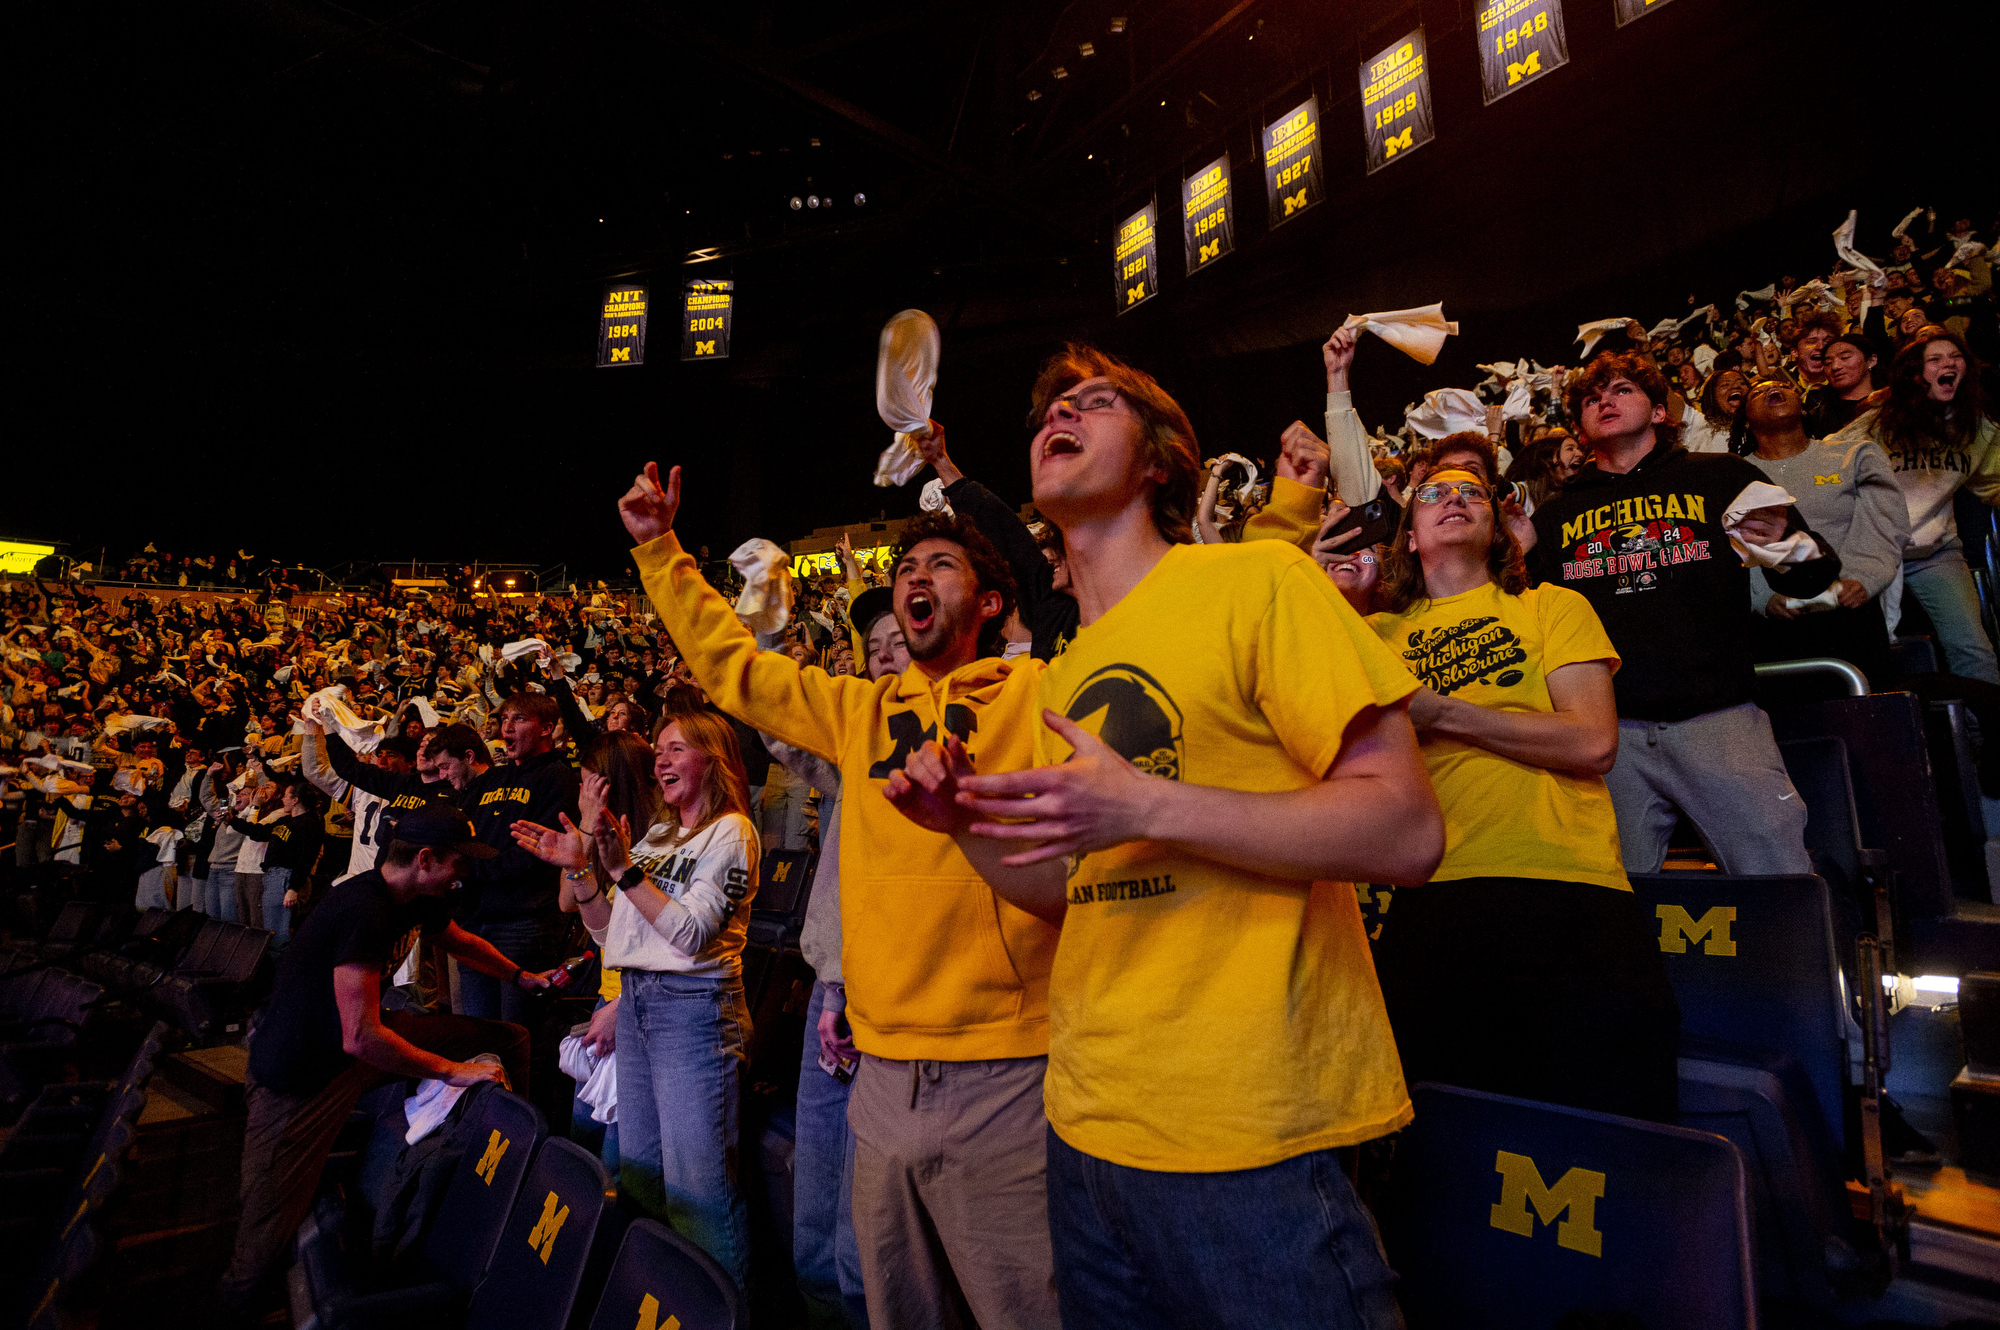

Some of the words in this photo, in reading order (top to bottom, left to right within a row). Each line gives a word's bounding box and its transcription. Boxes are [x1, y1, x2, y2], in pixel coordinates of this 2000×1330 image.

[1496, 11, 1548, 54] 1948
[1364, 54, 1423, 99] CHAMPIONS
[1506, 50, 1541, 86] M
[1375, 91, 1417, 130] 1929
[1266, 121, 1316, 161] CHAMPIONS
[1385, 126, 1413, 158] M
[1276, 154, 1311, 189] 1927
[1186, 177, 1228, 212] CHAMPIONS
[1284, 187, 1307, 216] M
[1194, 207, 1225, 237] 1926
[1116, 226, 1153, 255] CHAMPIONS
[1199, 237, 1220, 263] M
[1123, 255, 1147, 280] 1921
[604, 302, 645, 312] CHAMPIONS
[609, 290, 643, 303] NIT
[687, 295, 730, 305] CHAMPIONS
[1127, 281, 1145, 305] M
[608, 324, 637, 338] 1984
[690, 317, 723, 332] 2004
[611, 347, 630, 362] M
[695, 340, 715, 355] M
[1889, 451, 1972, 476] CHIGAN
[1813, 473, 1842, 486] M
[1561, 493, 1708, 550] MICHIGAN
[1587, 541, 1603, 555] 20
[1663, 527, 1681, 542] 24
[1563, 559, 1604, 580] ROSE
[1606, 551, 1657, 575] BOWL
[1660, 540, 1712, 566] GAME
[1422, 632, 1446, 652] Great
[1449, 627, 1458, 635] to
[1460, 618, 1480, 630] Be
[1415, 627, 1504, 676] Michigan
[772, 862, 792, 882] M
[1097, 875, 1176, 902] FOOTBALL
[1655, 904, 1737, 957] M
[475, 1129, 510, 1186] M
[1489, 1149, 1606, 1258] M
[527, 1191, 570, 1265] M
